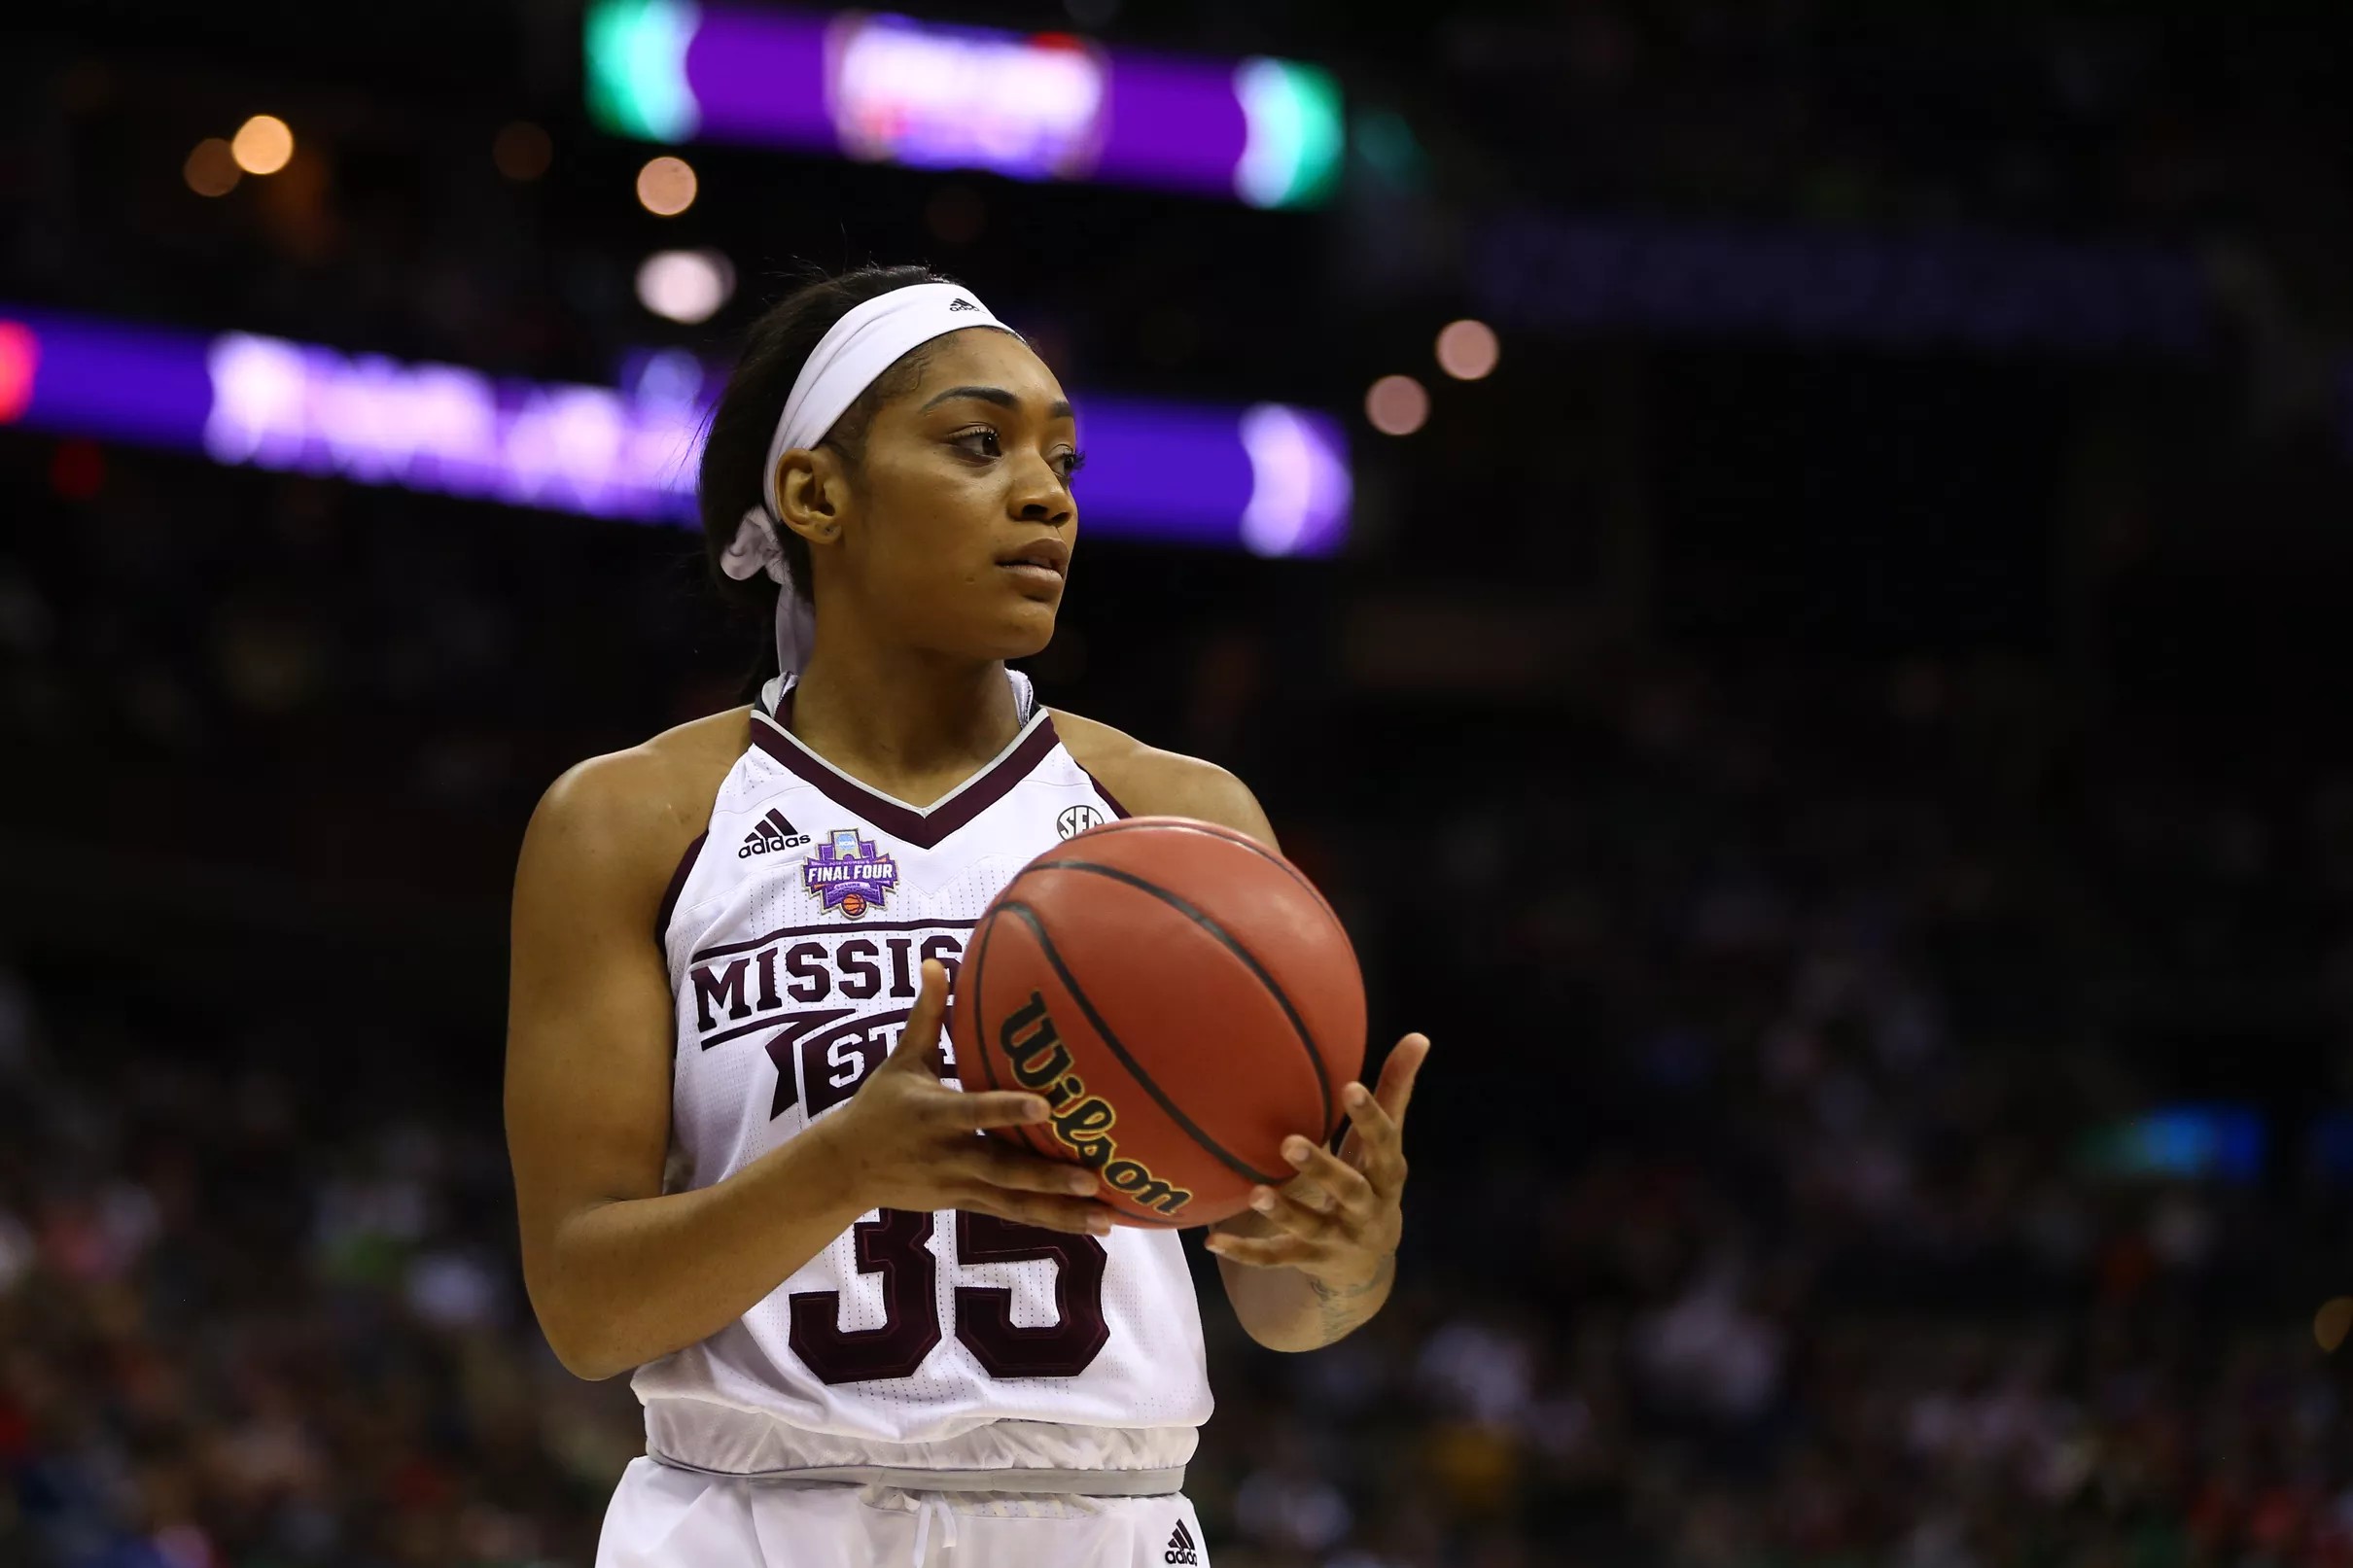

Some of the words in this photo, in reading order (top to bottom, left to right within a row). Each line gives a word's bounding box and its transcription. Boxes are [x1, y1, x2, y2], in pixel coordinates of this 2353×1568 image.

[738, 834, 811, 858] adidas
[808, 865, 851, 883] FINAL
[853, 863, 893, 880] FOUR
[1000, 987, 1194, 1215] Wilson
[789, 1208, 1110, 1384] 35
